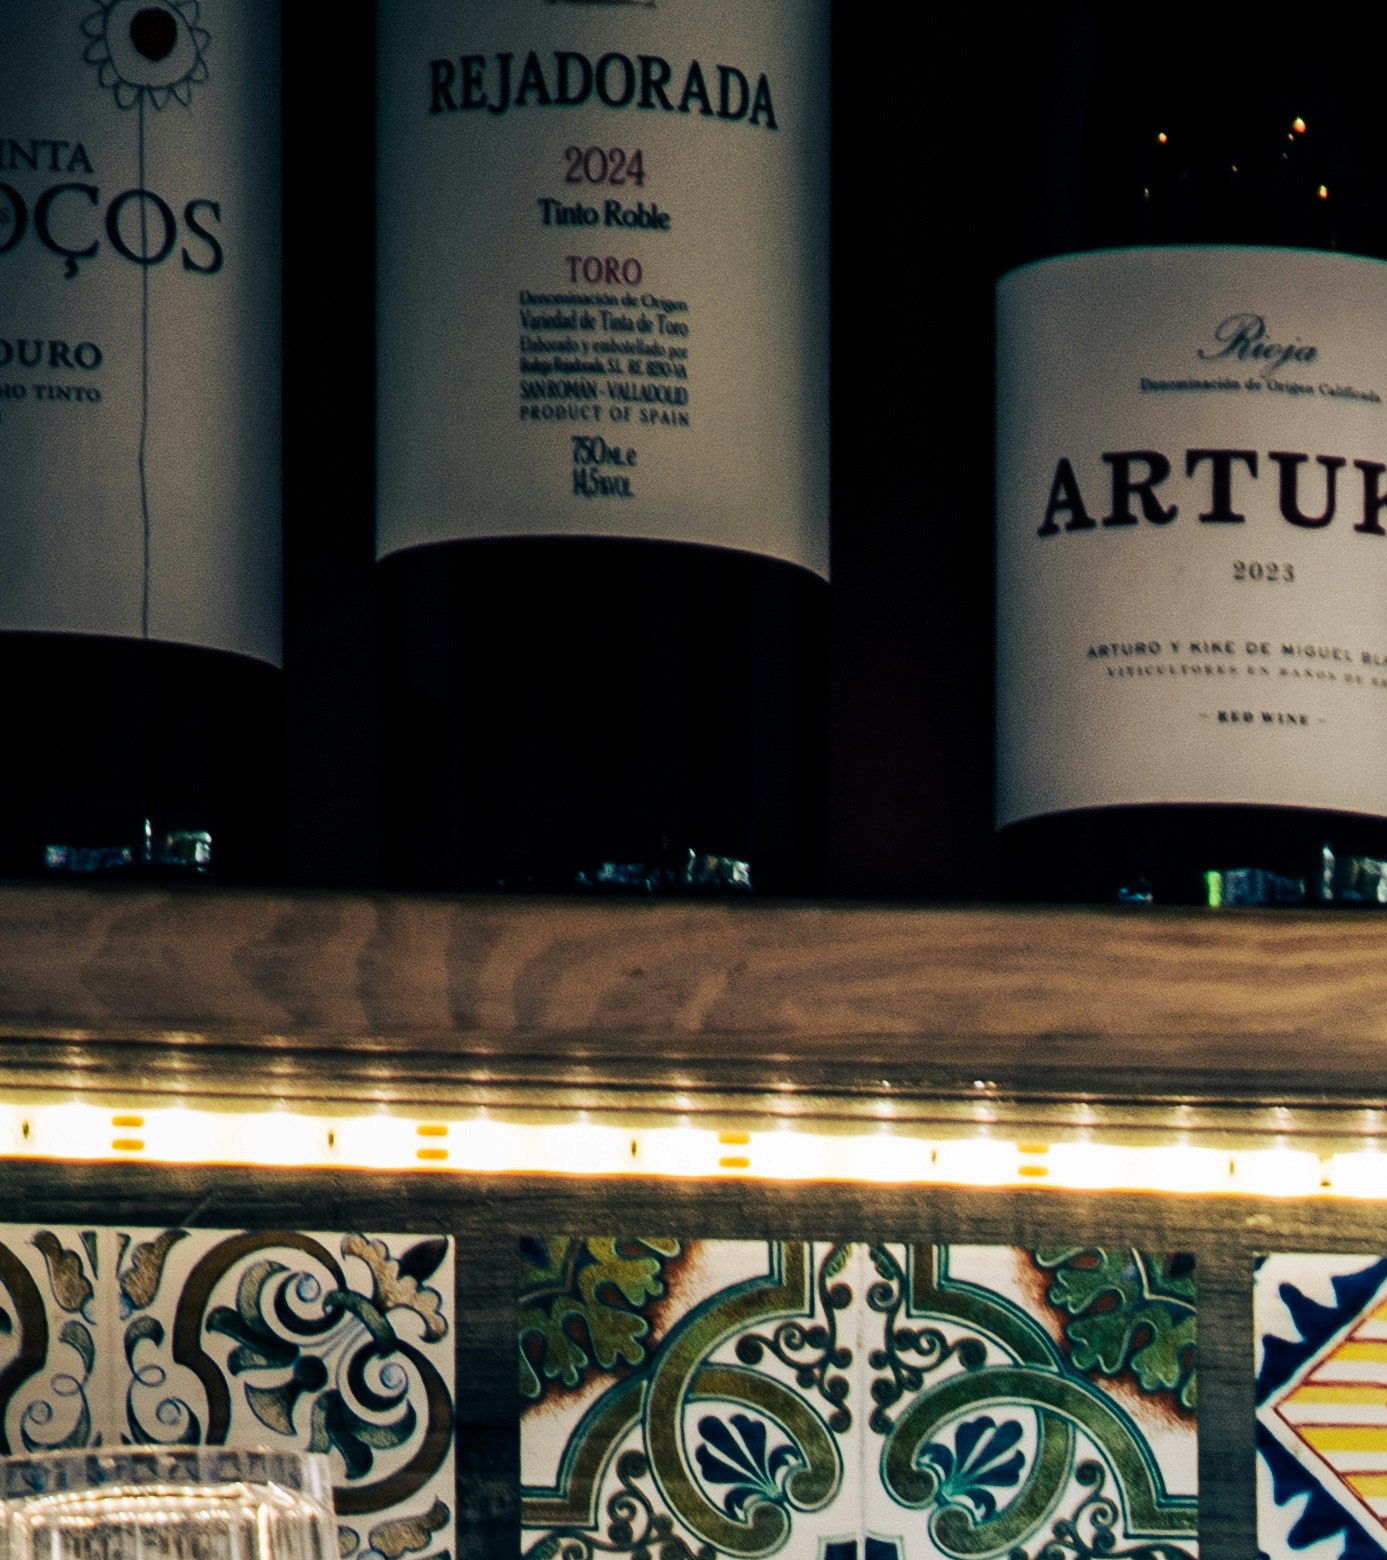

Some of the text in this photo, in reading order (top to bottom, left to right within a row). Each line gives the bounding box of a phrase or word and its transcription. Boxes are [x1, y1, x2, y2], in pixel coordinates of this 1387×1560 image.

[429, 50, 779, 130] REJADORADA
[565, 145, 645, 186] 2024
[537, 197, 671, 231] Tinto Roble
[566, 255, 643, 286] TORO
[658, 313, 689, 337] Toro
[1196, 312, 1318, 380] Rioja
[33, 383, 102, 402] TINTO
[1245, 378, 1261, 391] de
[520, 405, 689, 427] PRODUCT OF SPAIN
[1232, 559, 1295, 584] 2023
[1086, 640, 1161, 660] ARTURO
[1169, 640, 1180, 654] Y
[1190, 640, 1235, 656] KIKE
[1246, 641, 1271, 656] DE
[1281, 642, 1353, 662] MIGUEL
[1217, 710, 1310, 727] RED WINE
